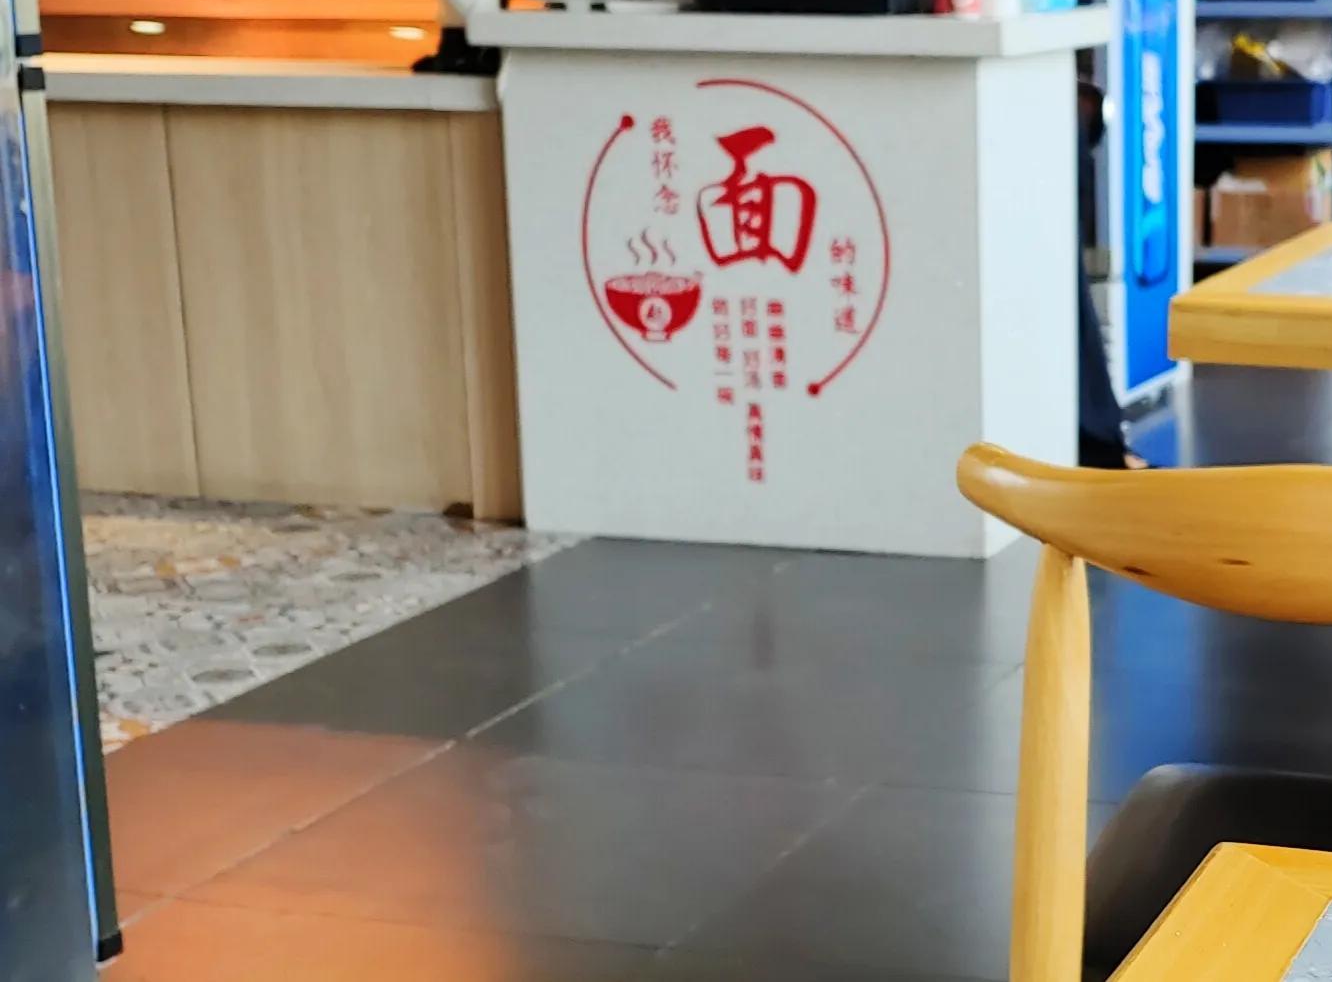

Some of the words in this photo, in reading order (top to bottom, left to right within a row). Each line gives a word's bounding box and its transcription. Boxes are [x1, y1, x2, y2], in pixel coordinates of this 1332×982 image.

[650, 117, 680, 215] 我怀念
[696, 126, 816, 273] 面
[829, 235, 860, 334] 的味道
